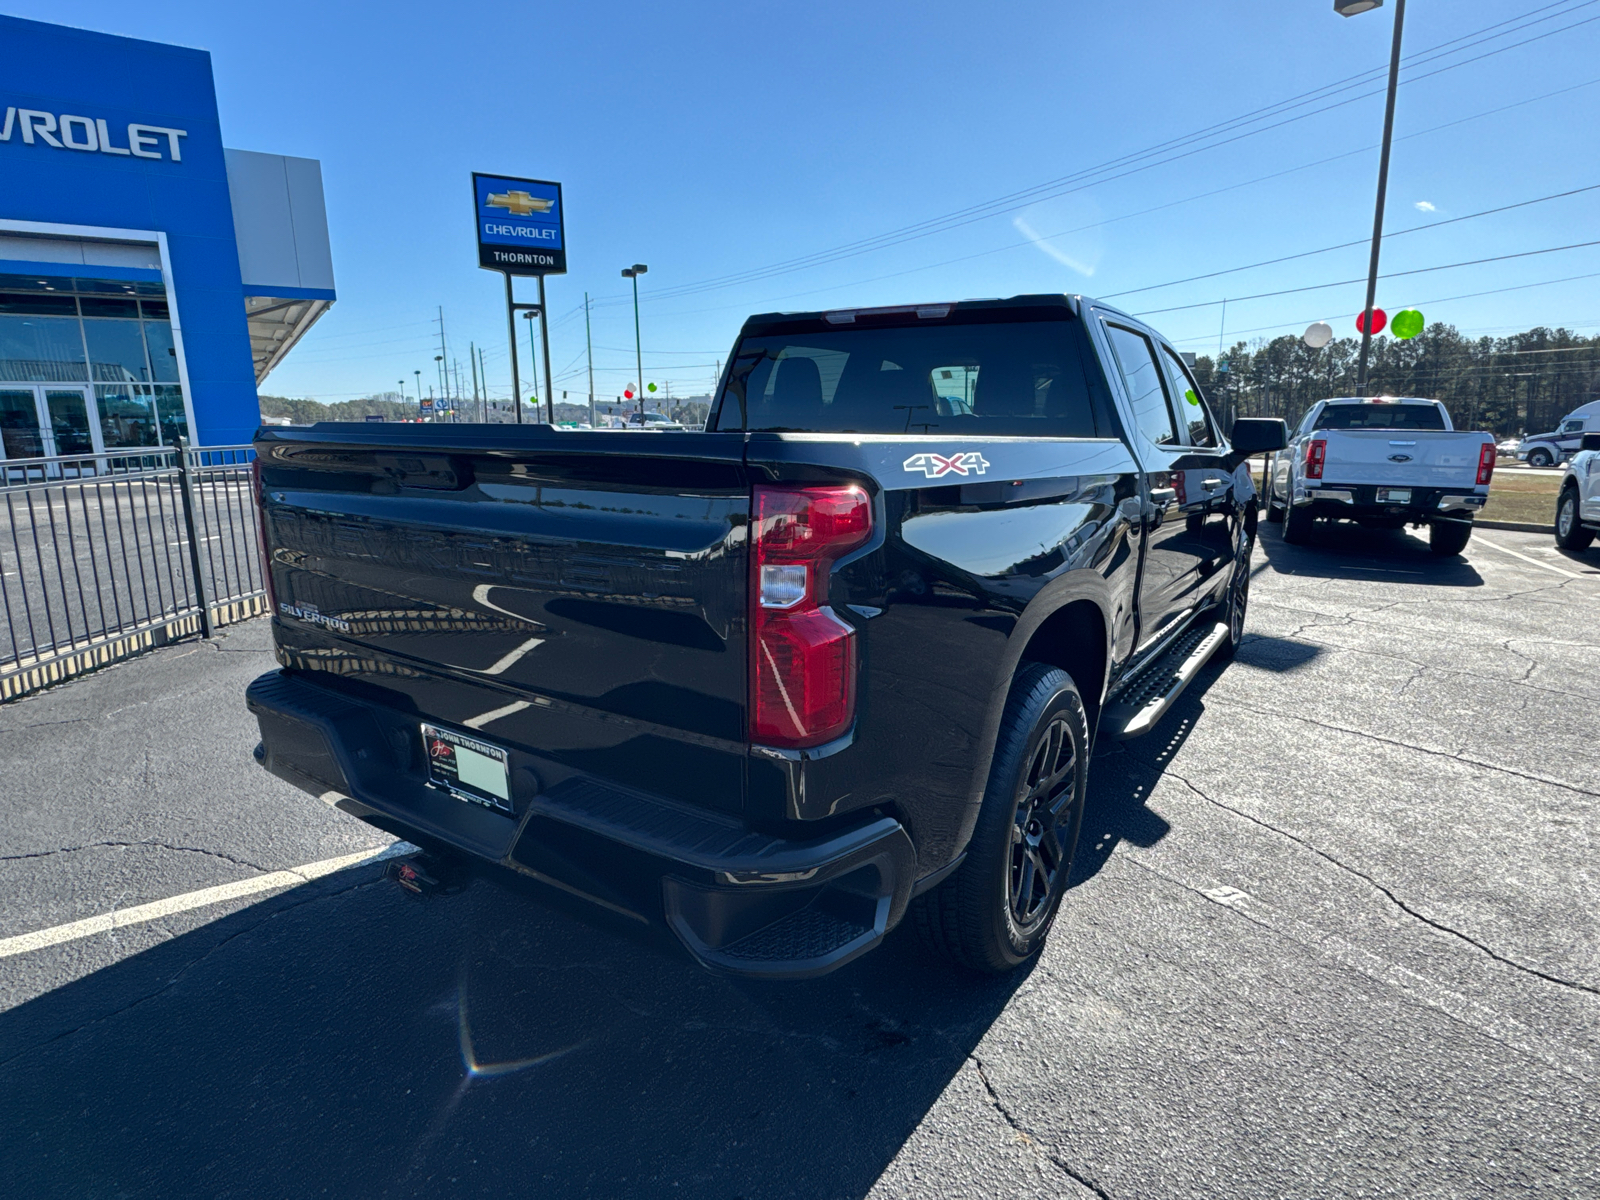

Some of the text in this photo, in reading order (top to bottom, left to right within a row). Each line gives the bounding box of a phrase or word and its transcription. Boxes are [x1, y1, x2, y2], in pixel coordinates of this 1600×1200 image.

[485, 223, 557, 240] CHEVROLET
[493, 251, 554, 265] THORNTON
[280, 602, 350, 631] SILVERADO
[440, 731, 502, 759] JOHN THORNTON
